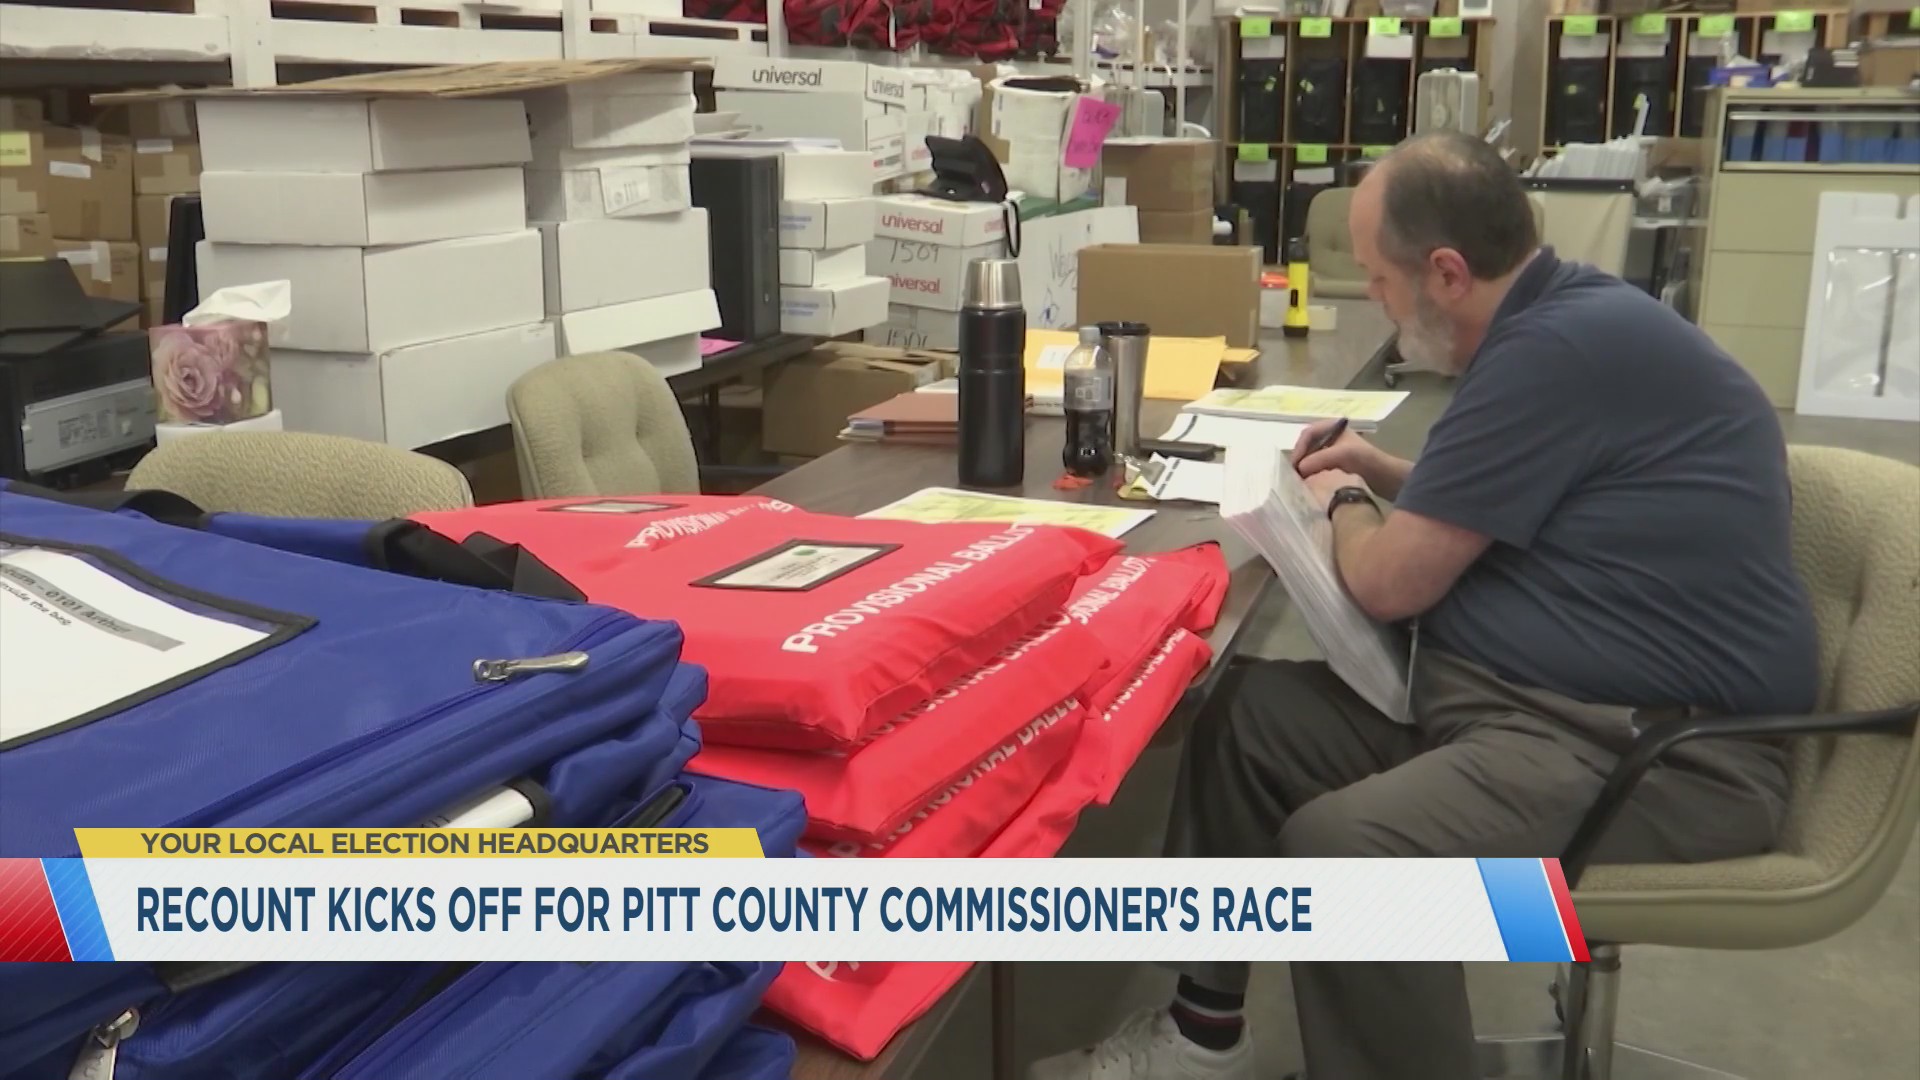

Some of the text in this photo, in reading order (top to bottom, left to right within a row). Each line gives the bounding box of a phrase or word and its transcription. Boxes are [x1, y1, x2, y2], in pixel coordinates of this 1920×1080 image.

[752, 65, 823, 86] universal
[872, 76, 905, 98] universal
[882, 212, 944, 234] universal
[887, 274, 942, 294] niversal
[781, 561, 973, 653] PROVISIONAL
